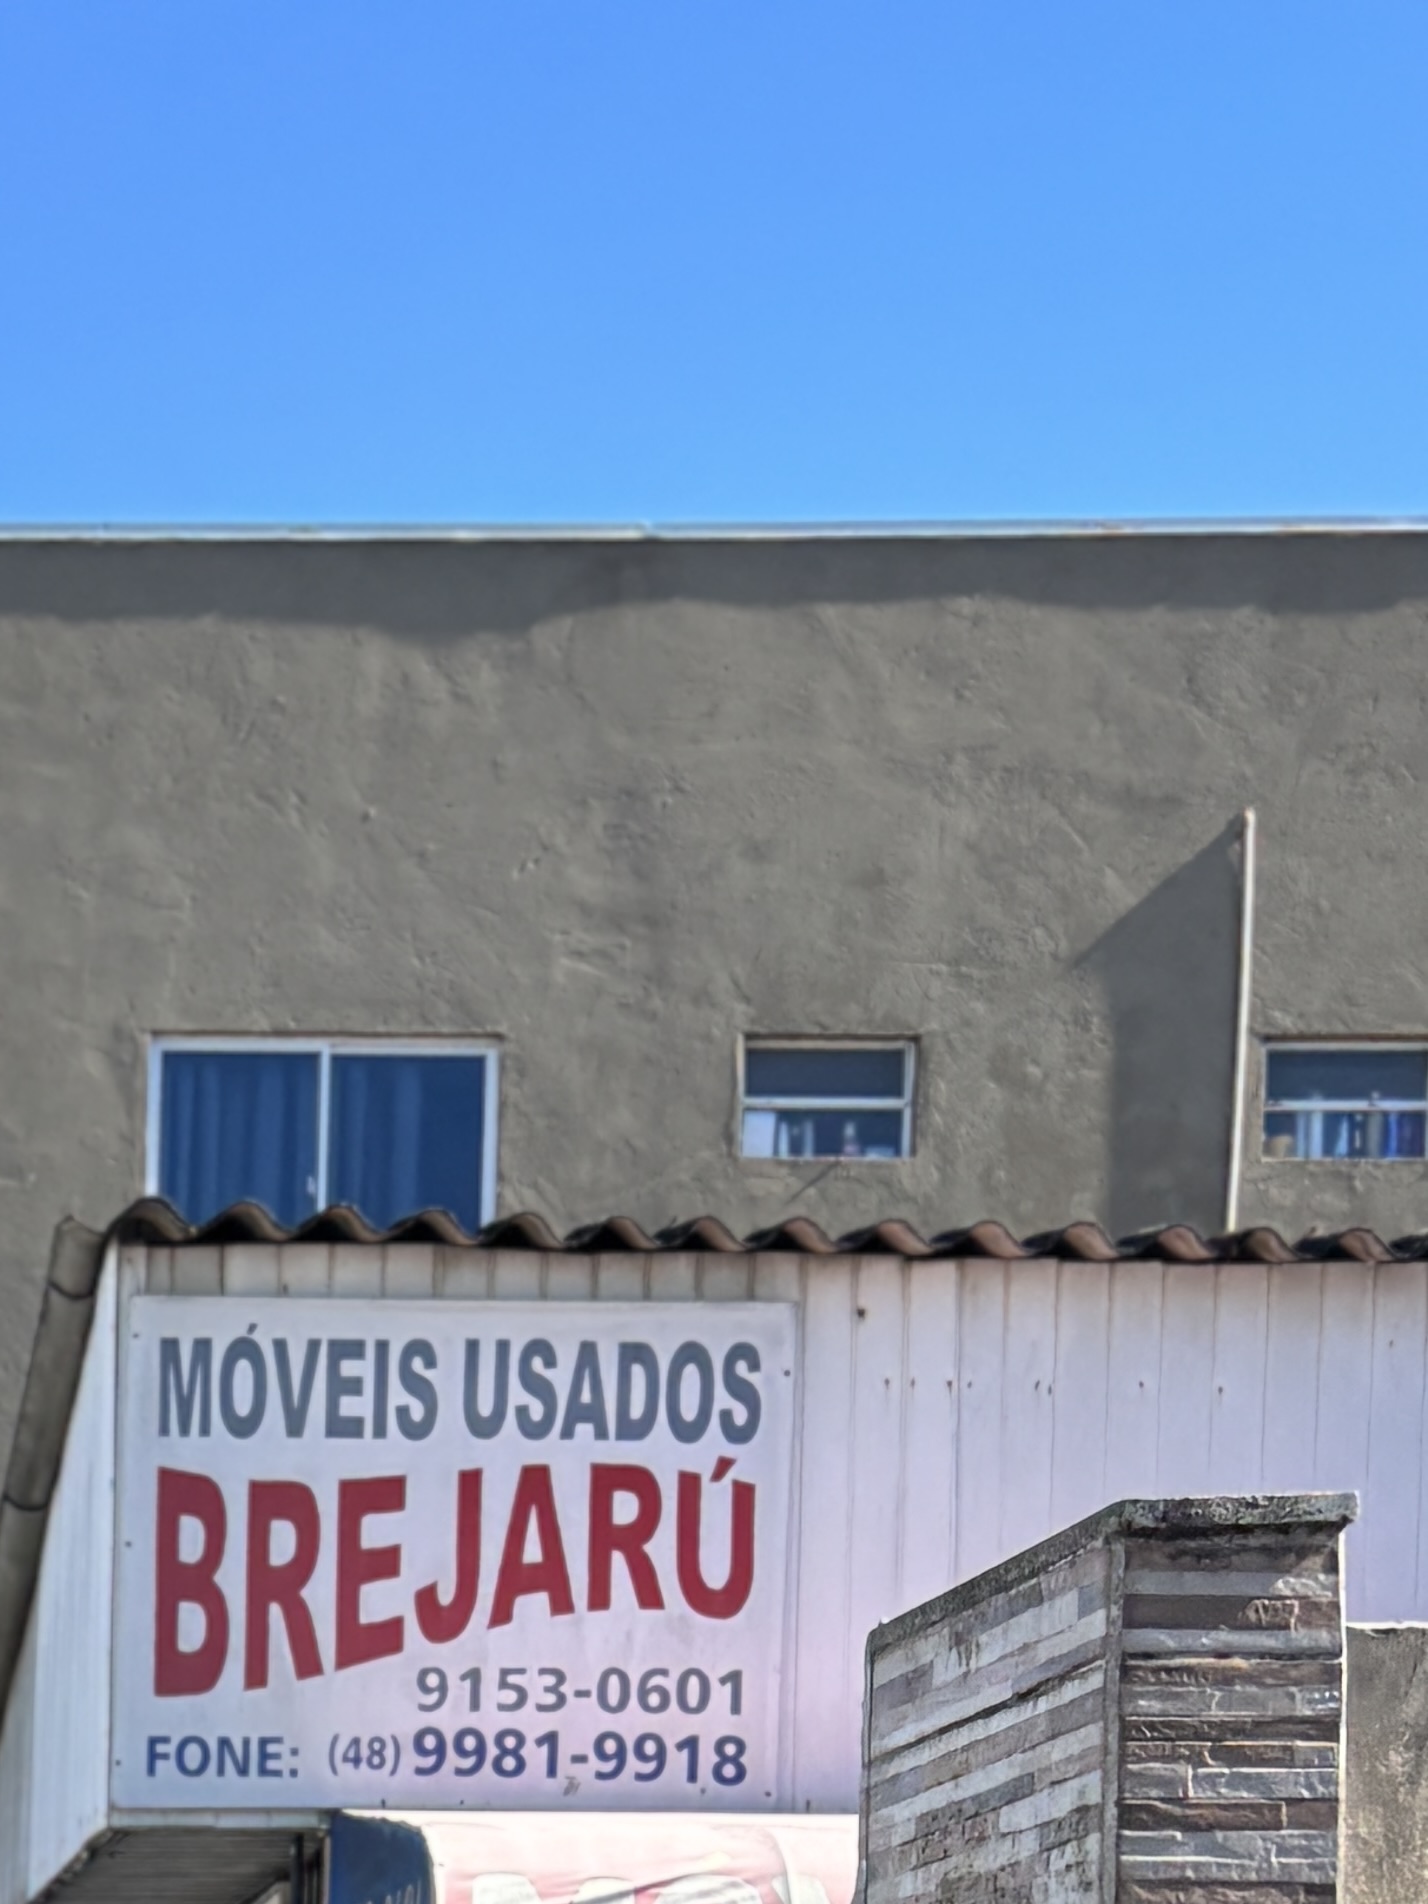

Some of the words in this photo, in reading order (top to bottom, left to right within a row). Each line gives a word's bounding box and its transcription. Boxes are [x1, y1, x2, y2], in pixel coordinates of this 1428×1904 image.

[157, 1323, 439, 1441] MÓVEIS
[463, 1336, 763, 1445] USADOS
[153, 1455, 756, 1698] BREJARÚ
[414, 1665, 745, 1716] 9153-0601
[146, 1736, 300, 1778] FONE:
[328, 1733, 402, 1780] (48)
[412, 1727, 748, 1787] 9981-9918
